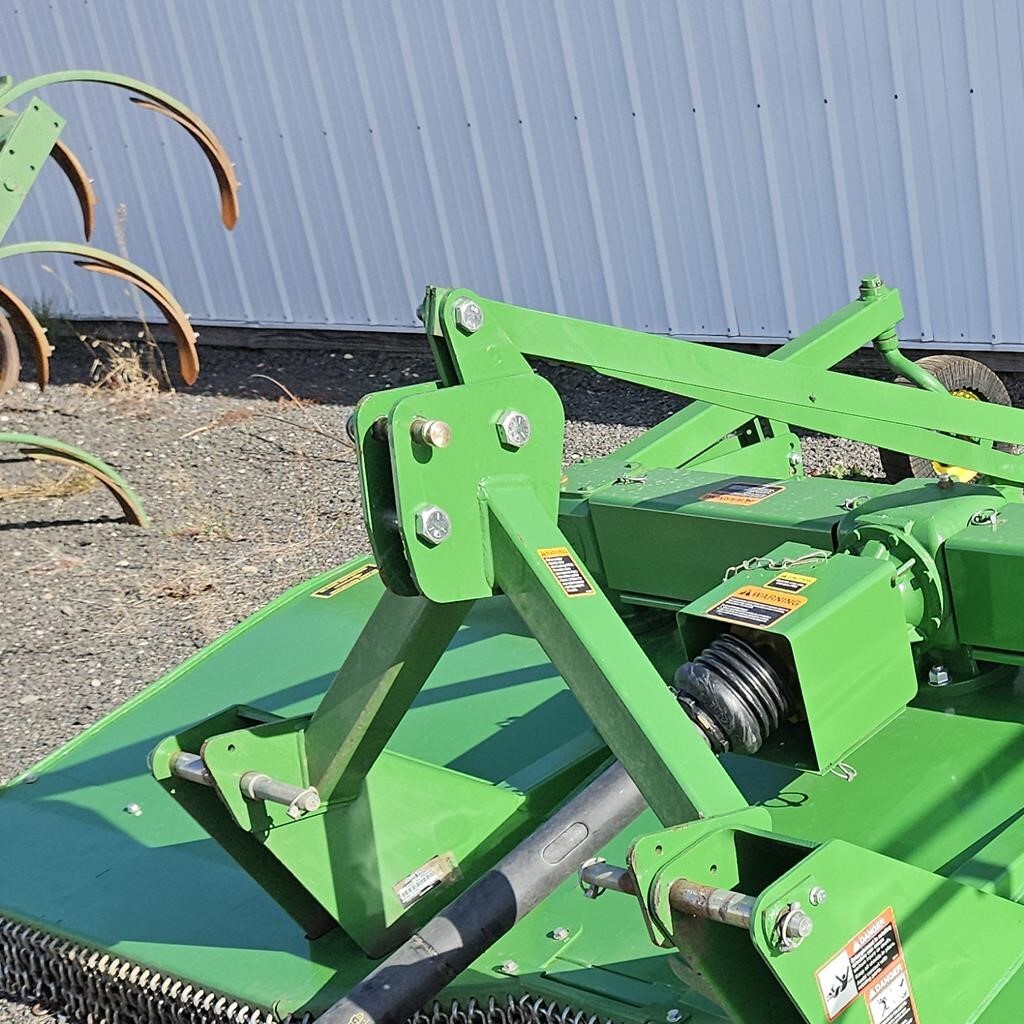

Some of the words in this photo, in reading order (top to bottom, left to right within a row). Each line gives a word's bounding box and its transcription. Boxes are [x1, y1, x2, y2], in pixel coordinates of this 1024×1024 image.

[752, 590, 802, 606] WARNING
[859, 918, 886, 945] DANGER
[875, 966, 903, 993] DANGER
